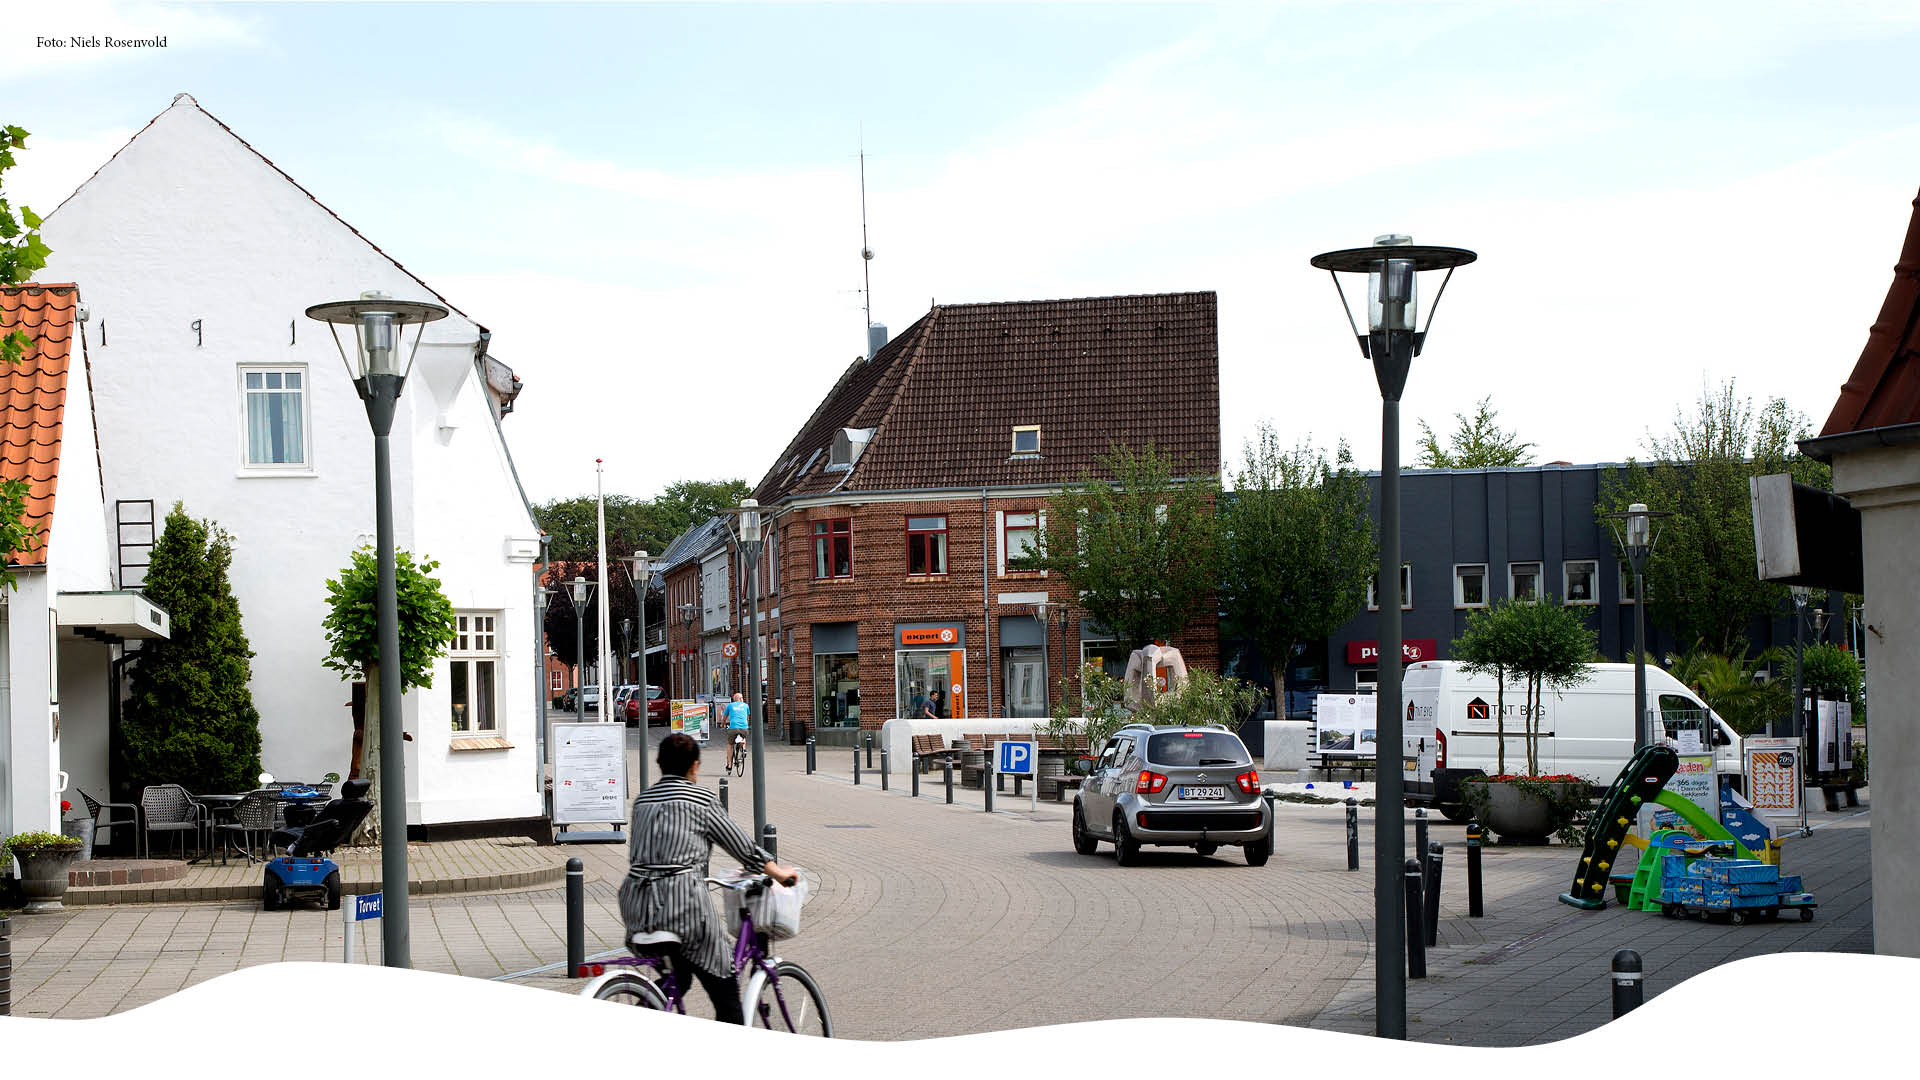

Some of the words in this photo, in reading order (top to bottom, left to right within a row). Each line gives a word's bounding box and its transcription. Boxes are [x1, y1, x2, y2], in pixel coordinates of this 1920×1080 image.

[906, 632, 939, 641] expert
[1491, 704, 1515, 715] TNT
[1520, 704, 1545, 716] BYG
[1010, 745, 1028, 770] P
[1779, 756, 1794, 764] 70%
[1756, 773, 1791, 784] SALE
[1185, 788, 1196, 796] BT
[1197, 788, 1207, 796] 29
[1209, 788, 1223, 796] 241
[1756, 783, 1791, 795] SALE
[1756, 794, 1791, 806] SALE
[359, 897, 380, 914] Torvet
